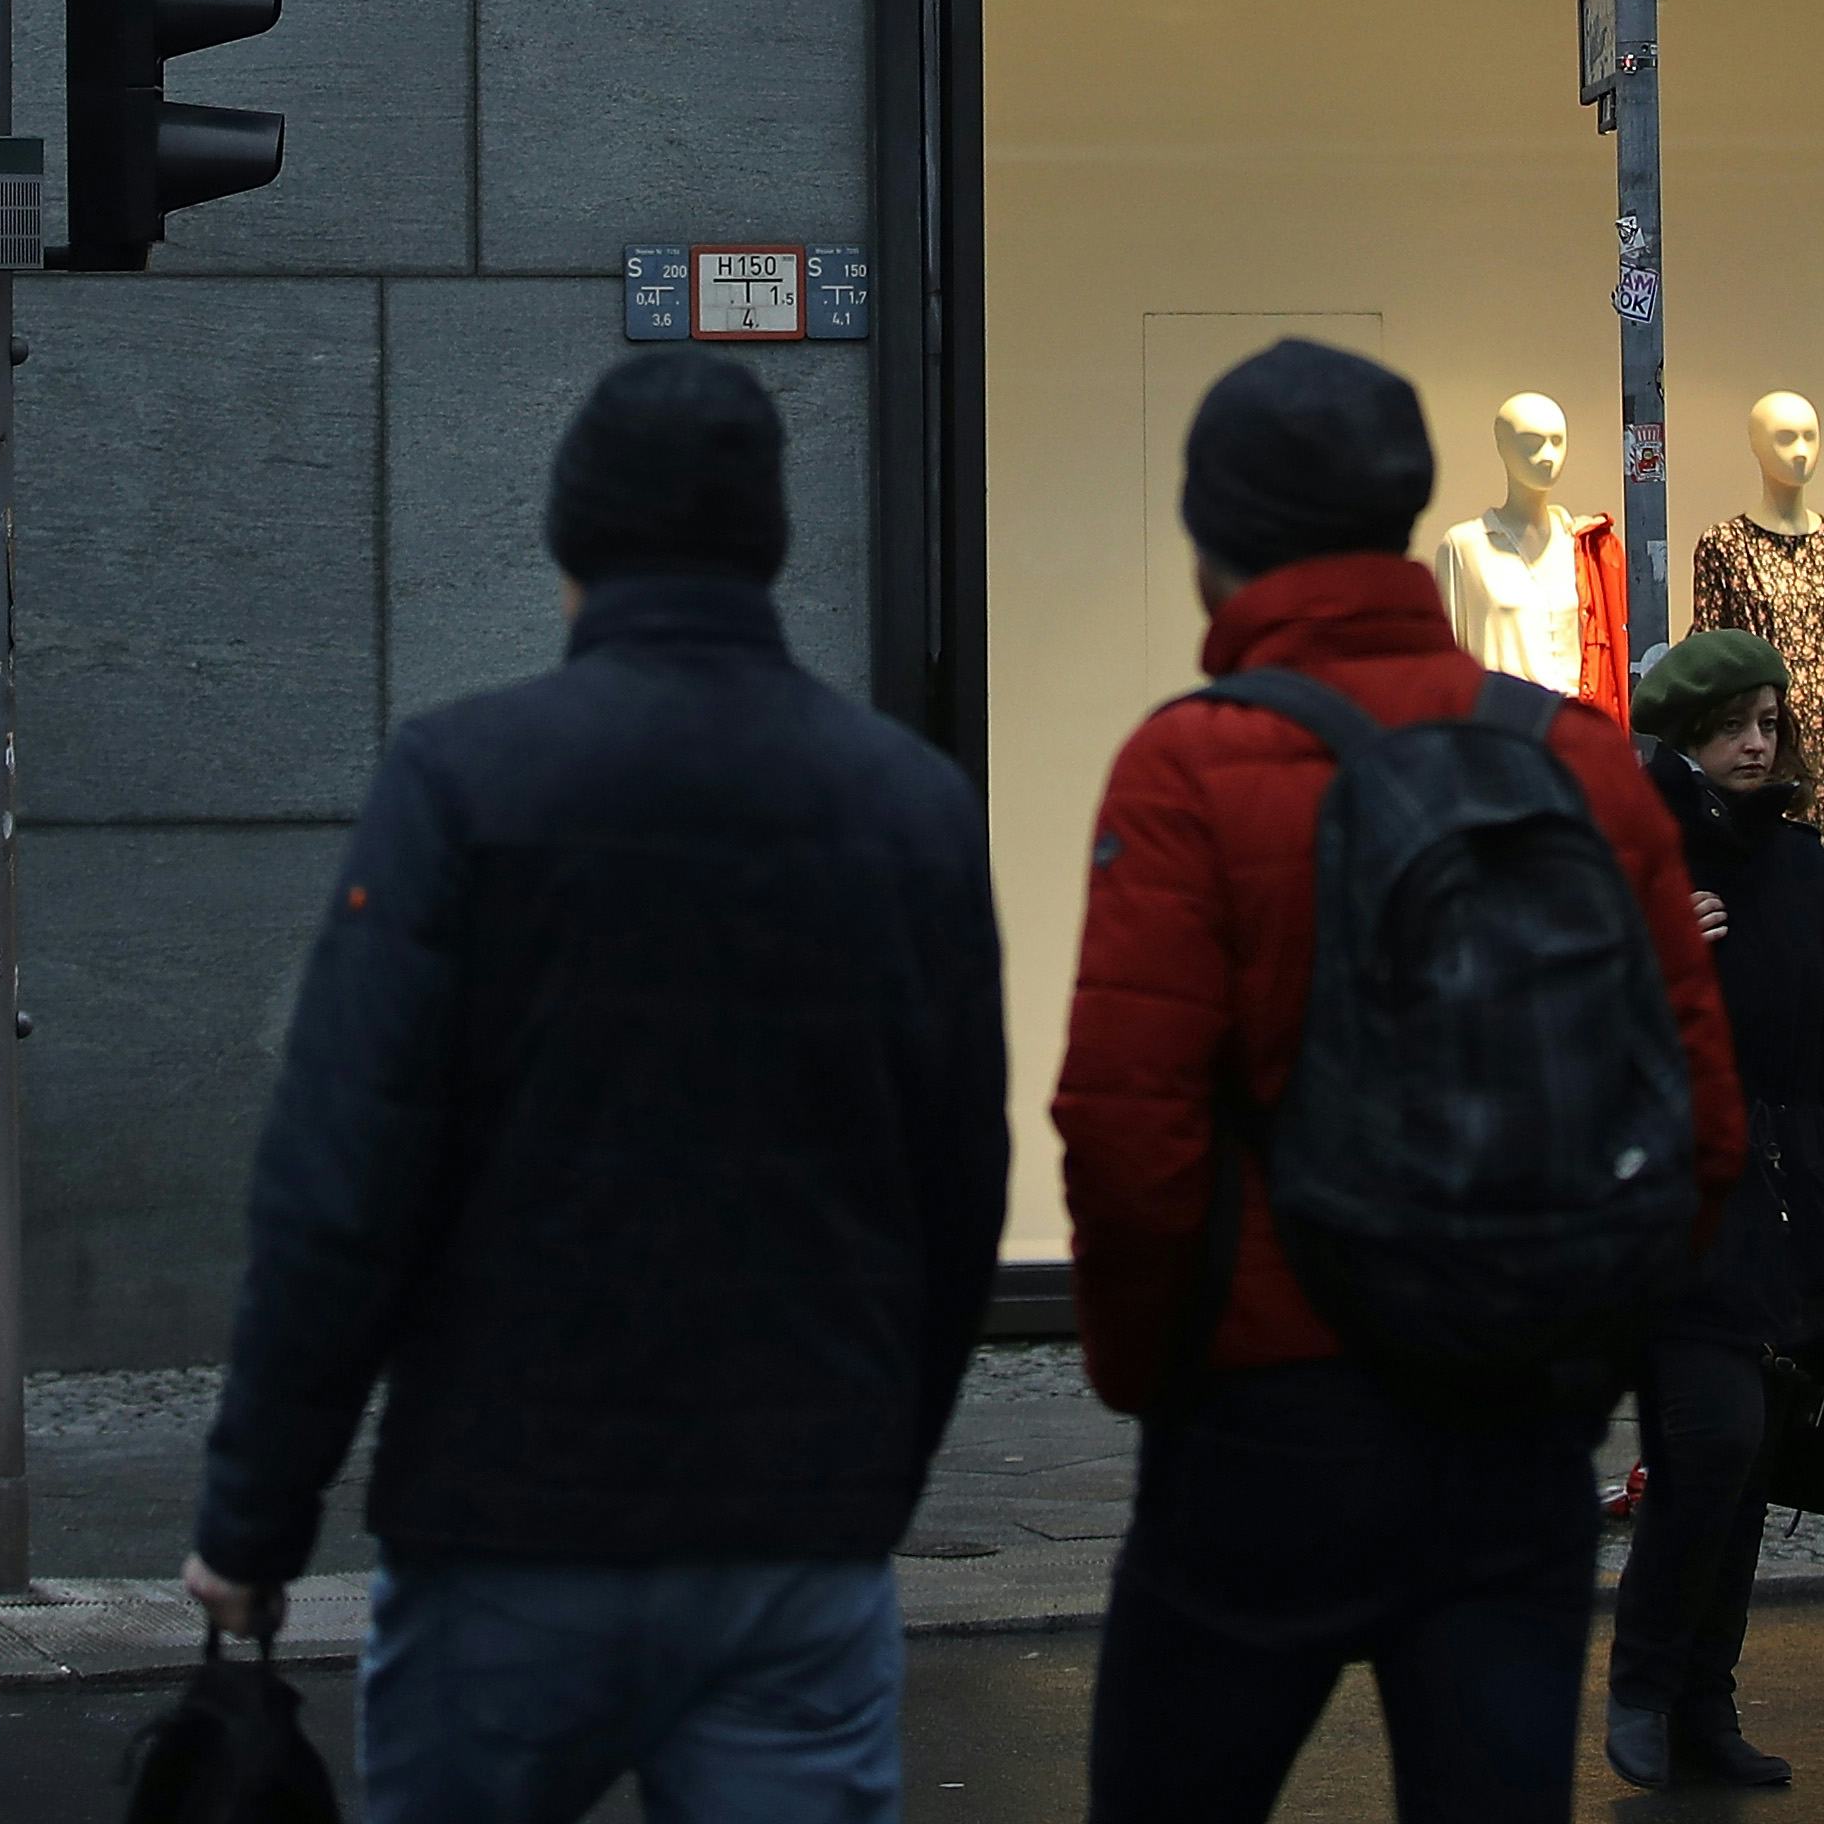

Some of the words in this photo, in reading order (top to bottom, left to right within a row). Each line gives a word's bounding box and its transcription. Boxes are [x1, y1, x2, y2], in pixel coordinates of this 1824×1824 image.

[627, 256, 643, 278] S
[662, 264, 688, 279] 200
[807, 256, 823, 277] S
[844, 263, 867, 278] 150
[1620, 291, 1650, 315] OK
